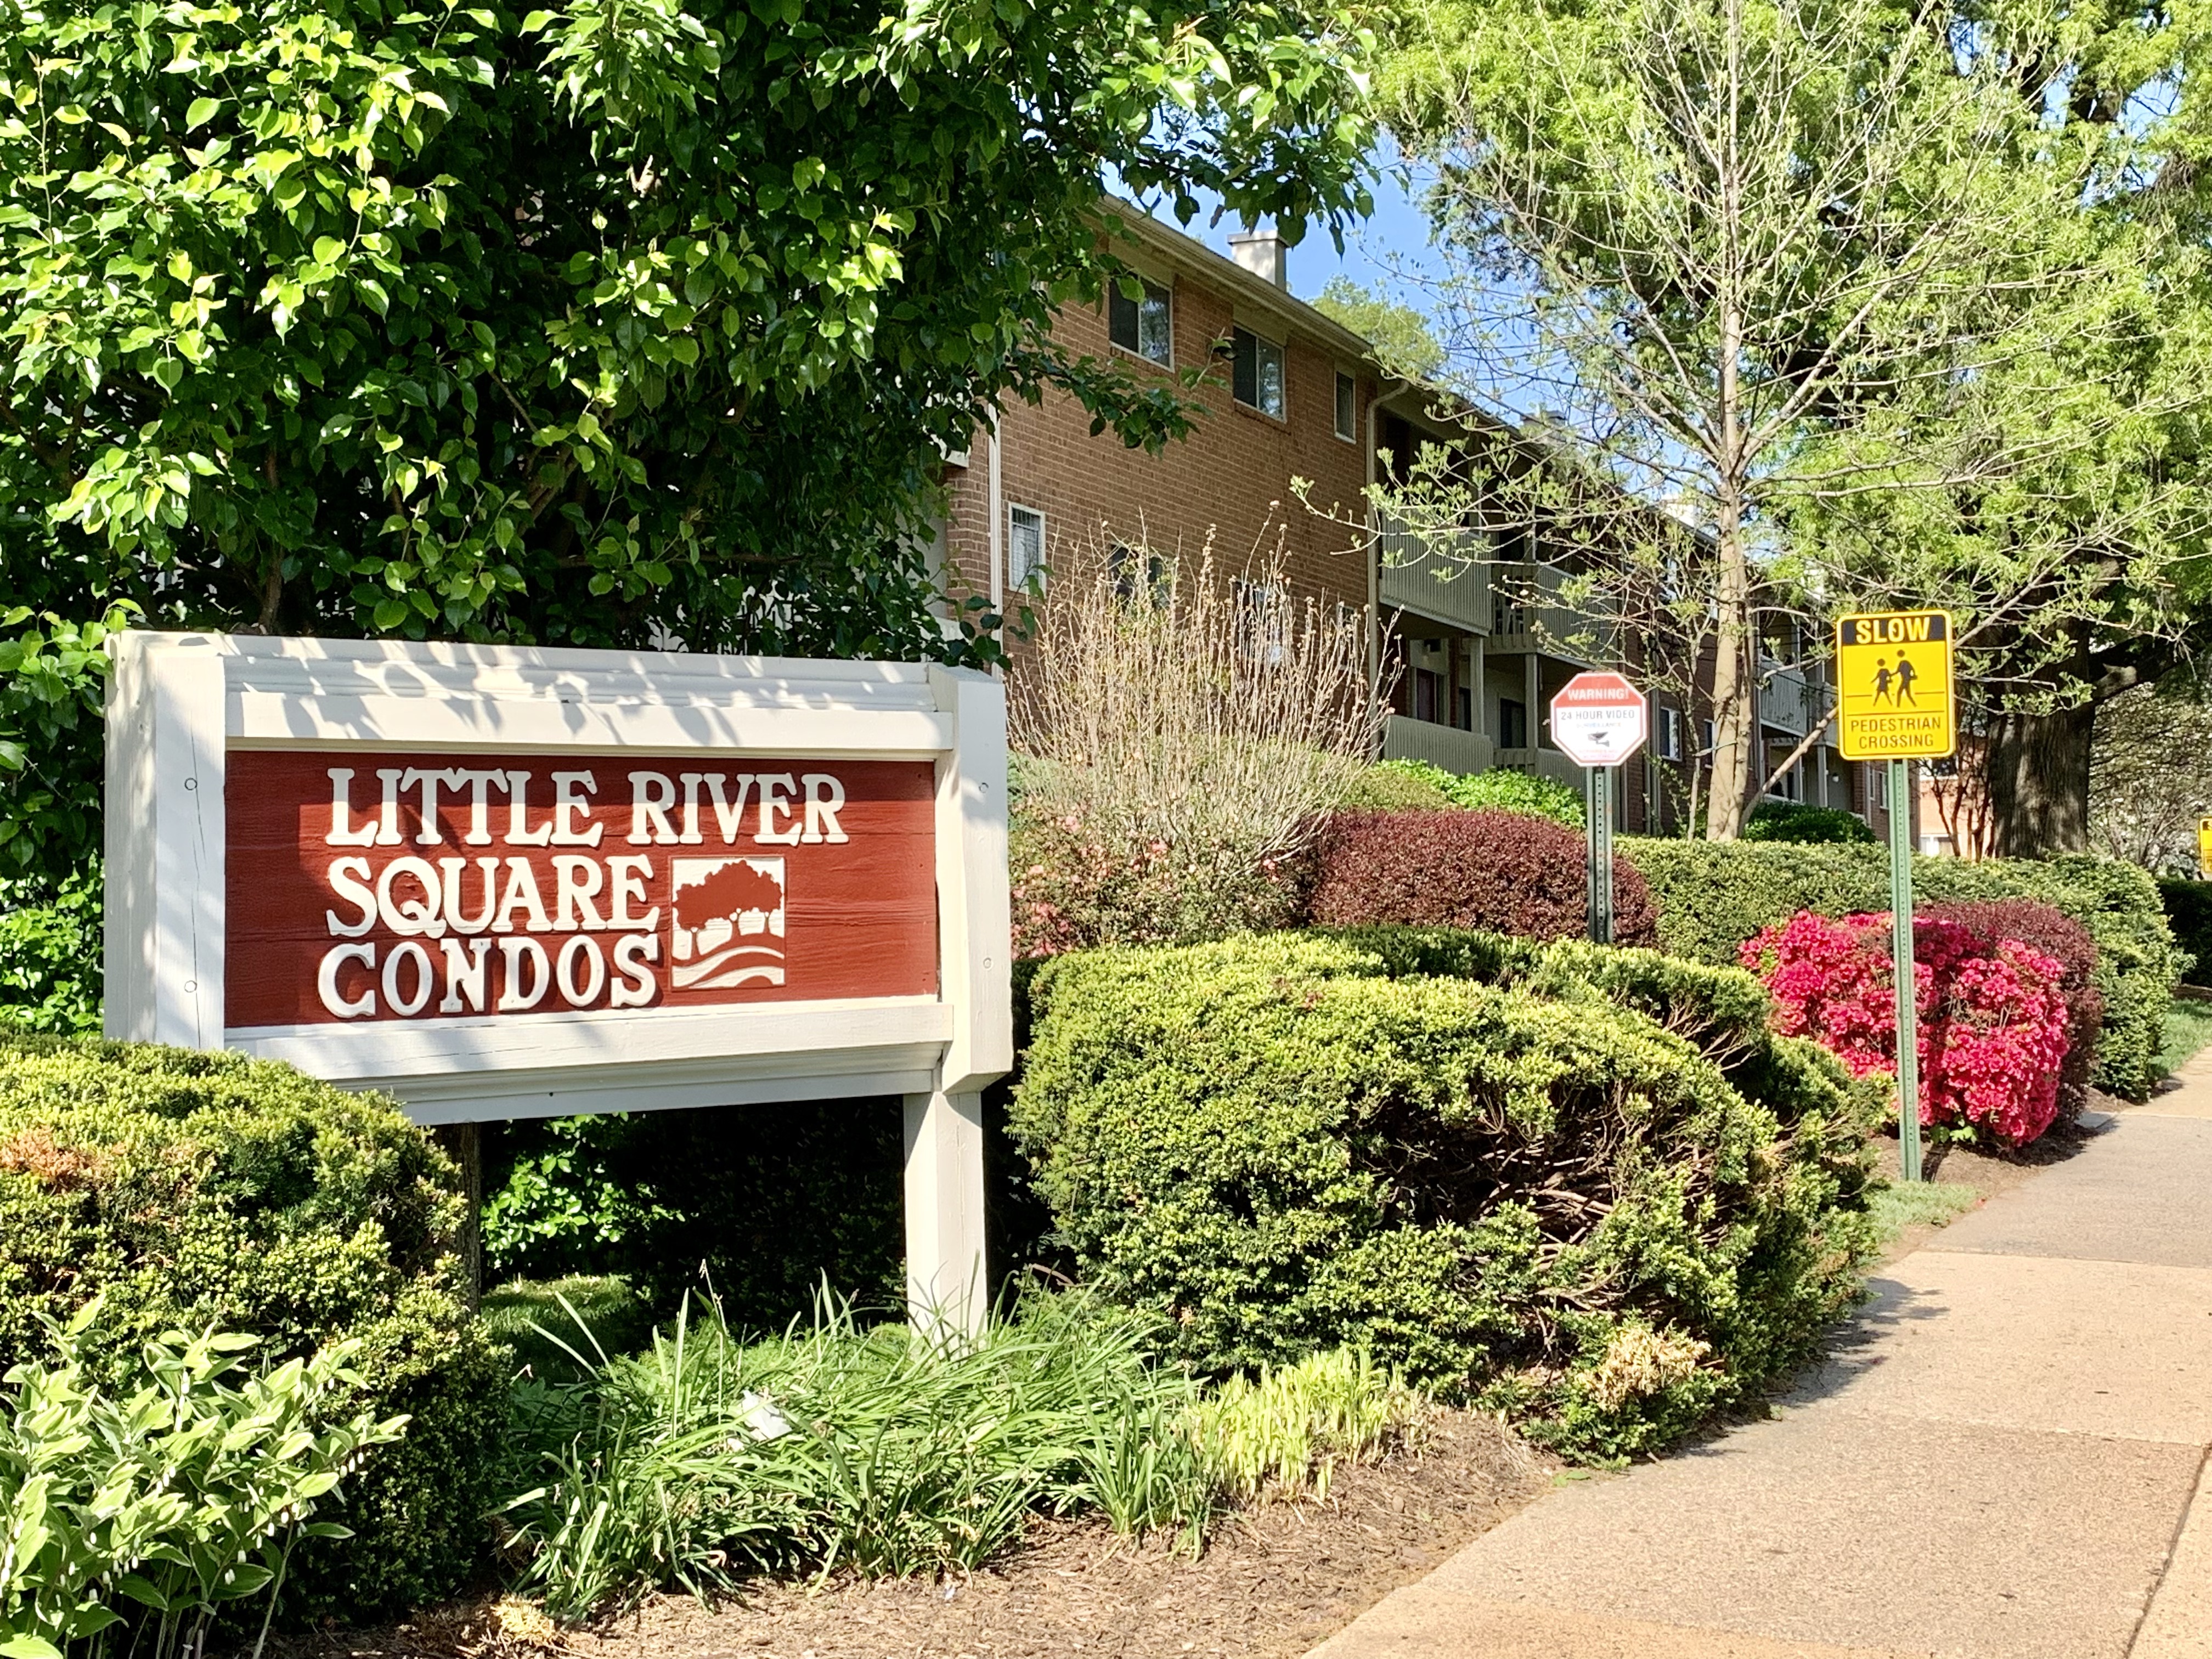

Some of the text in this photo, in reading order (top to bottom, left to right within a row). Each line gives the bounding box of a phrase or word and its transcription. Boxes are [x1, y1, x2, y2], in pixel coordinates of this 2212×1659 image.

[1856, 617, 1930, 644] SLOW
[1567, 688, 1629, 700] WARNING!
[1561, 709, 1635, 720] 24 HOUR VIDEO
[1851, 717, 1940, 732] PEDESTRIAN
[1859, 733, 1934, 749] CROSSING
[326, 767, 849, 848] LITTLE RIVER
[325, 854, 661, 938] SQUARE
[318, 933, 659, 1018] CONDOS
